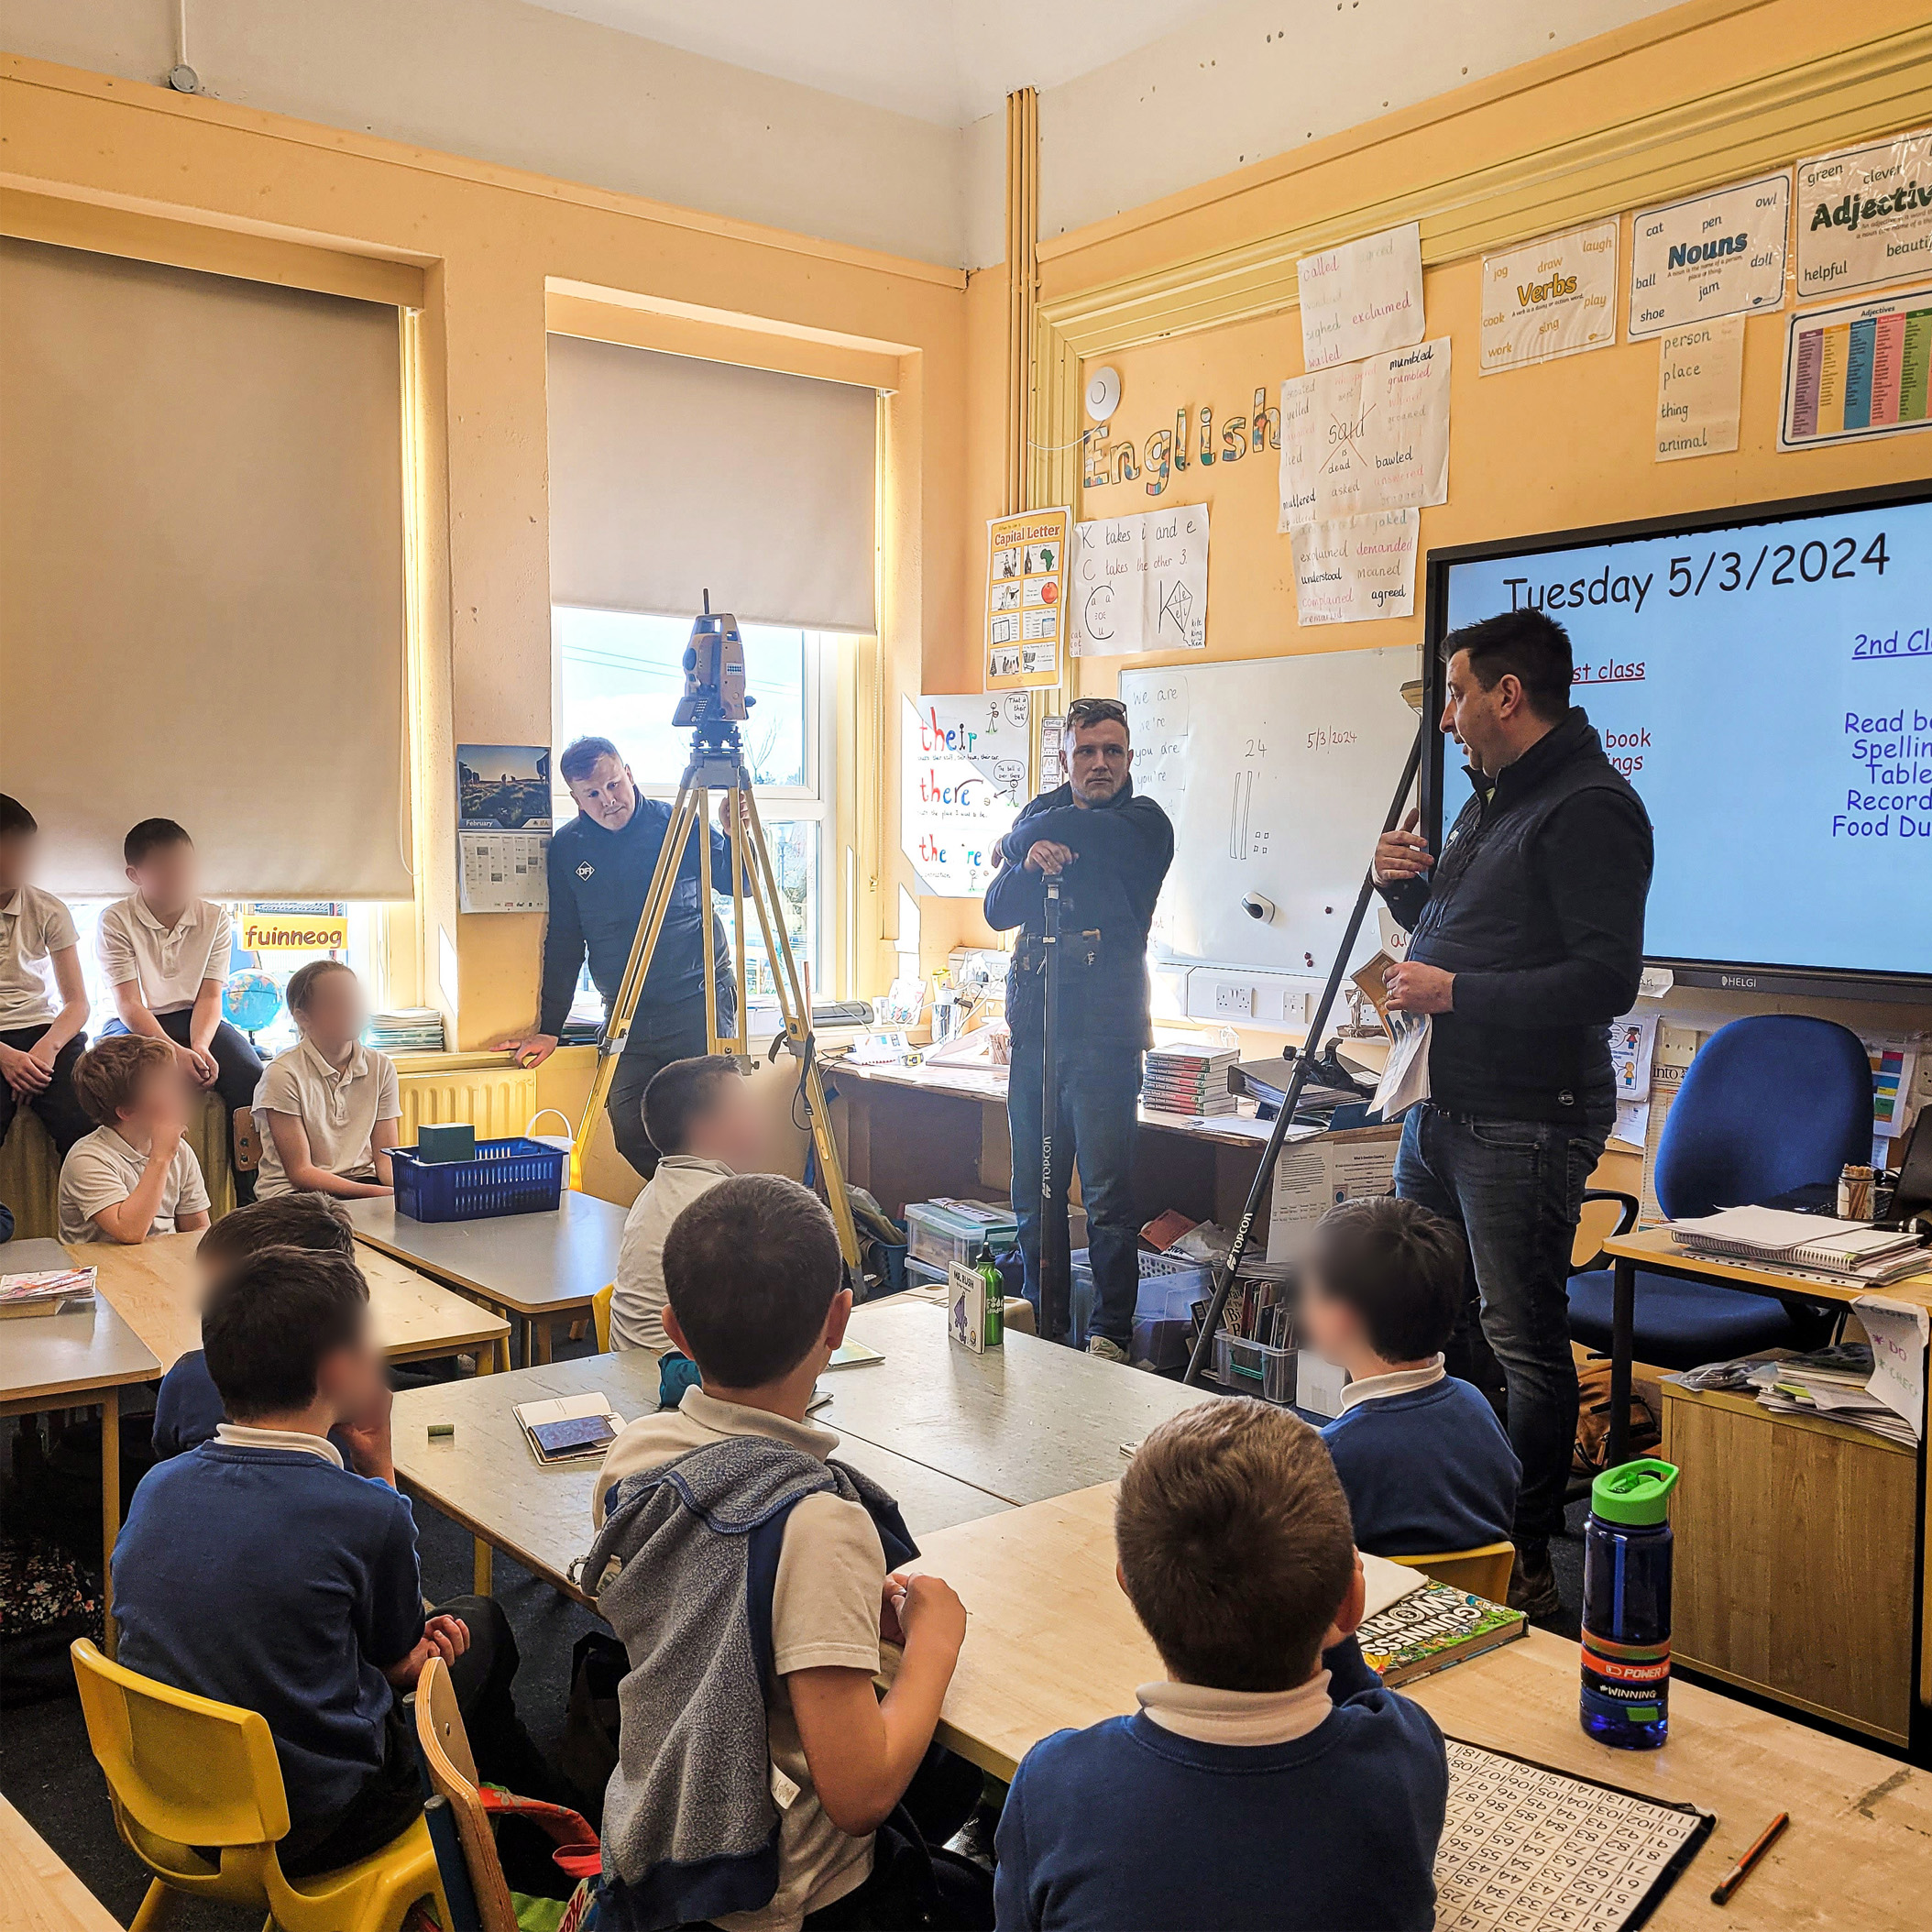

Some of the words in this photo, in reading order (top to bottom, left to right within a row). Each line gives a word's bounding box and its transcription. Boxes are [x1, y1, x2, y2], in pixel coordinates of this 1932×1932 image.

[1807, 165, 1843, 187] green
[1863, 165, 1903, 184] clever
[1755, 192, 1777, 207] owl
[1646, 223, 1663, 237] cat
[1702, 215, 1722, 233] pen
[1583, 237, 1612, 253] laugh
[1668, 233, 1748, 270] Nouns
[1303, 255, 1340, 281] called
[1537, 257, 1564, 273] draw
[1751, 253, 1773, 268] doll
[1493, 266, 1508, 281] jog
[1805, 260, 1848, 280] helpful
[1517, 273, 1577, 307] Verbs
[1636, 274, 1655, 290] ball
[1698, 281, 1720, 302] jam
[1352, 291, 1411, 324] exclaimed
[1584, 293, 1607, 309] play
[1641, 308, 1665, 322] shoe
[1861, 306, 1895, 317] Adjectives
[1483, 313, 1505, 328] cook
[1539, 319, 1559, 335] sing
[1306, 313, 1341, 346] sighed
[1488, 342, 1512, 357] work
[1664, 330, 1711, 359] person
[1389, 346, 1434, 370] mumbled
[1388, 365, 1432, 394] grumbled
[1663, 364, 1701, 390] place
[1286, 398, 1310, 425] yelled
[1661, 402, 1688, 423] thing
[1328, 401, 1366, 445] said
[1083, 387, 1281, 496] English
[1659, 427, 1707, 452] animal
[1342, 448, 1348, 457] is
[1376, 446, 1413, 469] bawled
[1328, 458, 1351, 474] dead
[1332, 479, 1360, 497] asked
[1375, 510, 1407, 534] joked
[994, 527, 1025, 547] Capital
[1026, 525, 1060, 539] Letter
[1081, 525, 1095, 549] K
[1105, 523, 1131, 545] takes
[1141, 523, 1146, 541] i
[1156, 517, 1178, 541] and
[1186, 521, 1197, 534] e
[1300, 540, 1348, 565] explained
[1356, 537, 1412, 555] demanded
[1082, 558, 1096, 581] C
[1105, 558, 1128, 576] takes
[1136, 559, 1148, 572] the
[1154, 558, 1173, 570] other
[1301, 567, 1342, 585] understood
[1503, 565, 1653, 613] Tuesday
[1668, 532, 1890, 597] 5/3/2024
[1301, 587, 1354, 609] complained
[1371, 585, 1407, 608] agreed
[1854, 631, 1898, 655] 2nd
[1573, 663, 1591, 681] st
[1598, 659, 1645, 679] class
[1157, 688, 1179, 700] are
[1845, 708, 1904, 733] Read
[919, 707, 977, 752] their
[1606, 727, 1652, 748] book
[1246, 740, 1267, 758] 24
[1307, 725, 1358, 753] 5/3/2024
[1134, 747, 1153, 766] you
[1161, 742, 1180, 754] are
[919, 768, 983, 806] there
[1136, 771, 1167, 794] you're
[466, 819, 493, 828] February
[1833, 814, 1889, 837] Food
[245, 925, 343, 950] fuinneog
[1729, 976, 1757, 988] HELGI
[1653, 1065, 1678, 1079] into
[1042, 1136, 1051, 1180] TOPCON
[1231, 1212, 1254, 1255] TOPCON
[961, 1275, 974, 1290] RUSH
[1360, 1606, 1483, 1655] GUINNESS
[1623, 1667, 1662, 1678] POWER
[1463, 1749, 1490, 1762] 118
[1451, 1759, 1478, 1773] 108
[1489, 1759, 1517, 1772] 117
[1478, 1770, 1507, 1783] 107
[1520, 1767, 1545, 1781] 116
[1466, 1781, 1488, 1791] 97
[1509, 1778, 1535, 1791] 106
[1548, 1776, 1575, 1790] 115
[1498, 1787, 1518, 1800] 96
[1536, 1788, 1564, 1801] 105
[1578, 1785, 1604, 1799] 114
[1525, 1798, 1547, 1810] 95
[1567, 1796, 1593, 1810] 104
[1606, 1795, 1633, 1808] 113
[1556, 1807, 1576, 1820] 94
[1596, 1806, 1624, 1820] 103
[1636, 1805, 1664, 1817] 112
[1586, 1817, 1608, 1829] 93
[1626, 1816, 1654, 1829] 102
[1666, 1814, 1696, 1828] 111
[1616, 1827, 1640, 1839] 92
[1657, 1825, 1686, 1839] 101
[1605, 1839, 1630, 1851] 82
[1648, 1837, 1668, 1849] 91
[1638, 1848, 1661, 1861] 81
